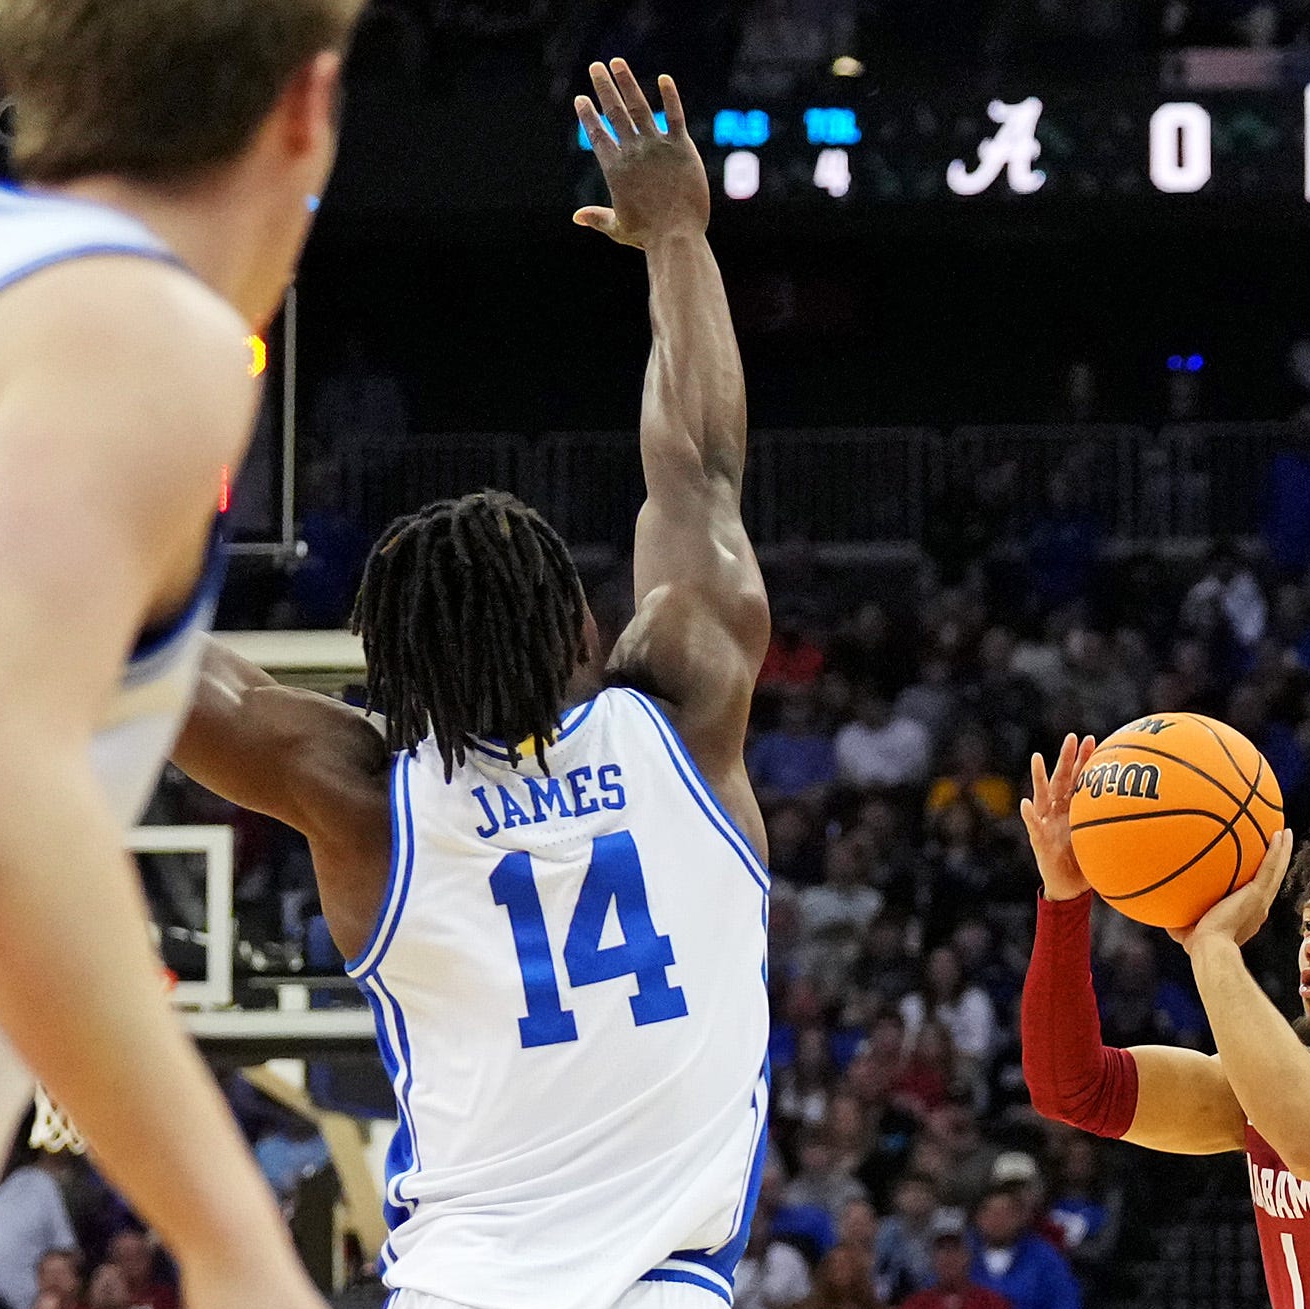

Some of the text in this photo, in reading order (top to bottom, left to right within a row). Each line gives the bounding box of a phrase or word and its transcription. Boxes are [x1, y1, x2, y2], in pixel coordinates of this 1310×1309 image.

[945, 94, 1047, 195] A
[1148, 102, 1212, 193] 0
[471, 762, 628, 840] JAMES
[488, 829, 690, 1050] 14
